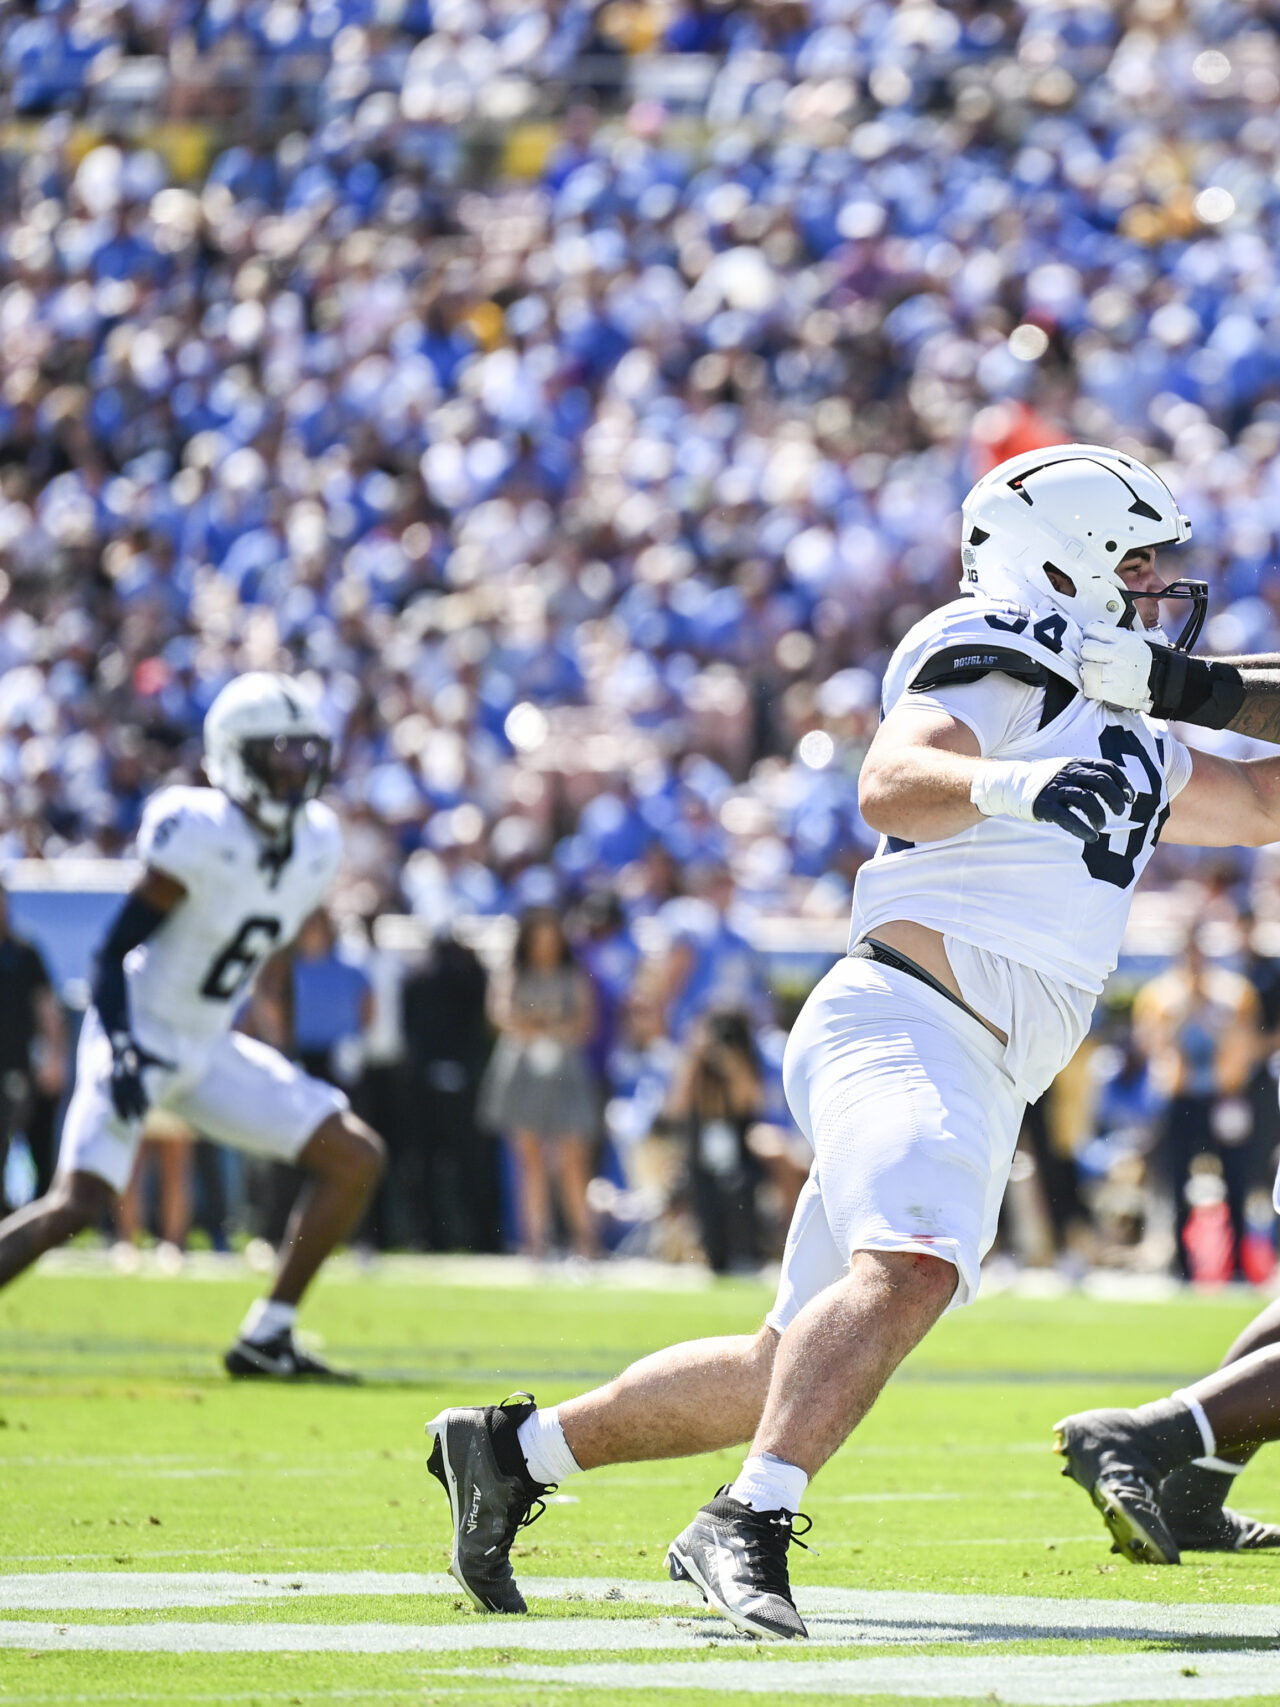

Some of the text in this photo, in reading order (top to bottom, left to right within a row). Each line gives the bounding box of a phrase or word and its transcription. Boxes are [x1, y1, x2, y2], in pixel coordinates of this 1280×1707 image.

[1081, 723, 1172, 890] 9
[199, 916, 280, 1001] 6
[466, 1483, 482, 1535] ALPHA
